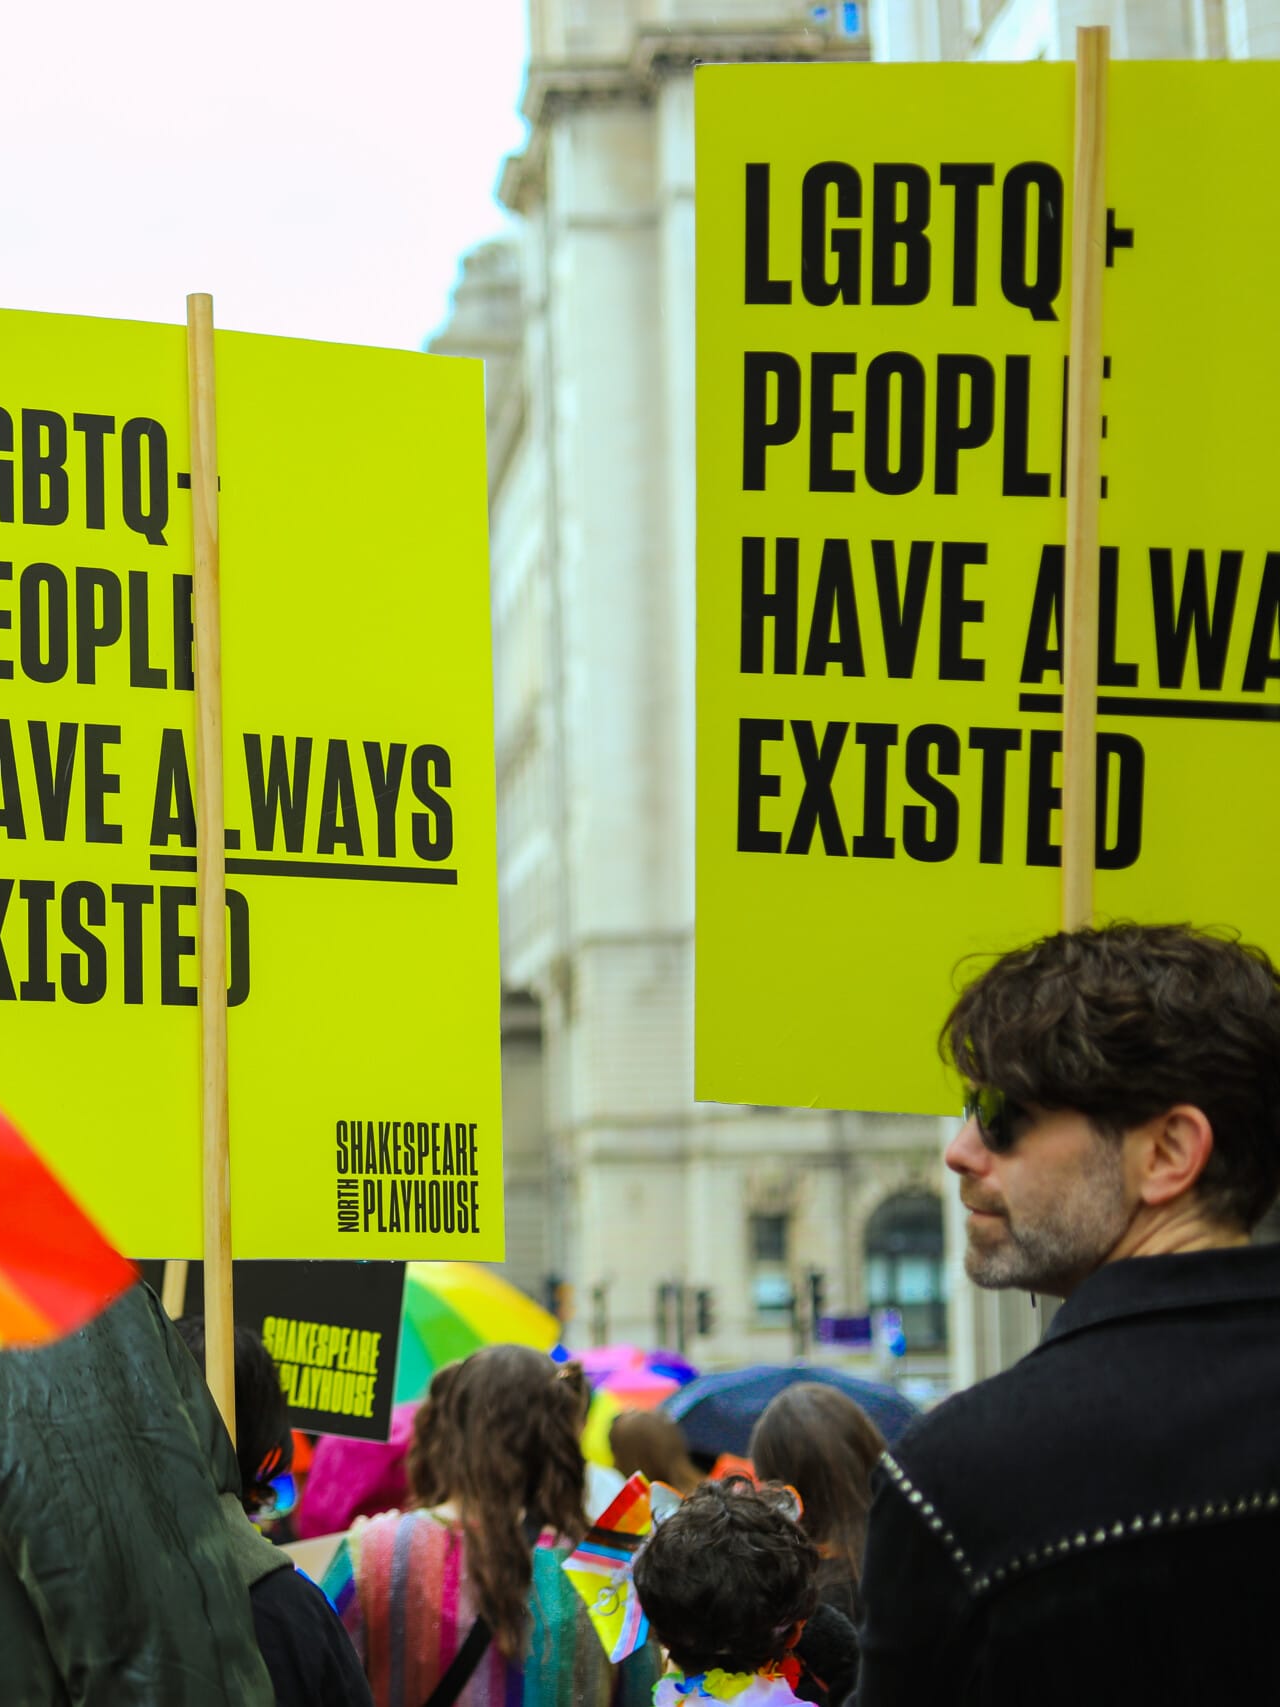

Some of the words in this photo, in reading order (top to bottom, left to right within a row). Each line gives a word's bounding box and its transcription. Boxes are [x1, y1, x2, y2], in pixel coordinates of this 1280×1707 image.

[739, 536, 988, 682] HAVE
[736, 717, 1146, 871] EXISTED
[336, 1120, 478, 1176] SHAKESPEARE
[337, 1178, 360, 1232] NORTH
[363, 1179, 480, 1233] PLAYHOUSE
[261, 1315, 382, 1374] SHAKESPEARE
